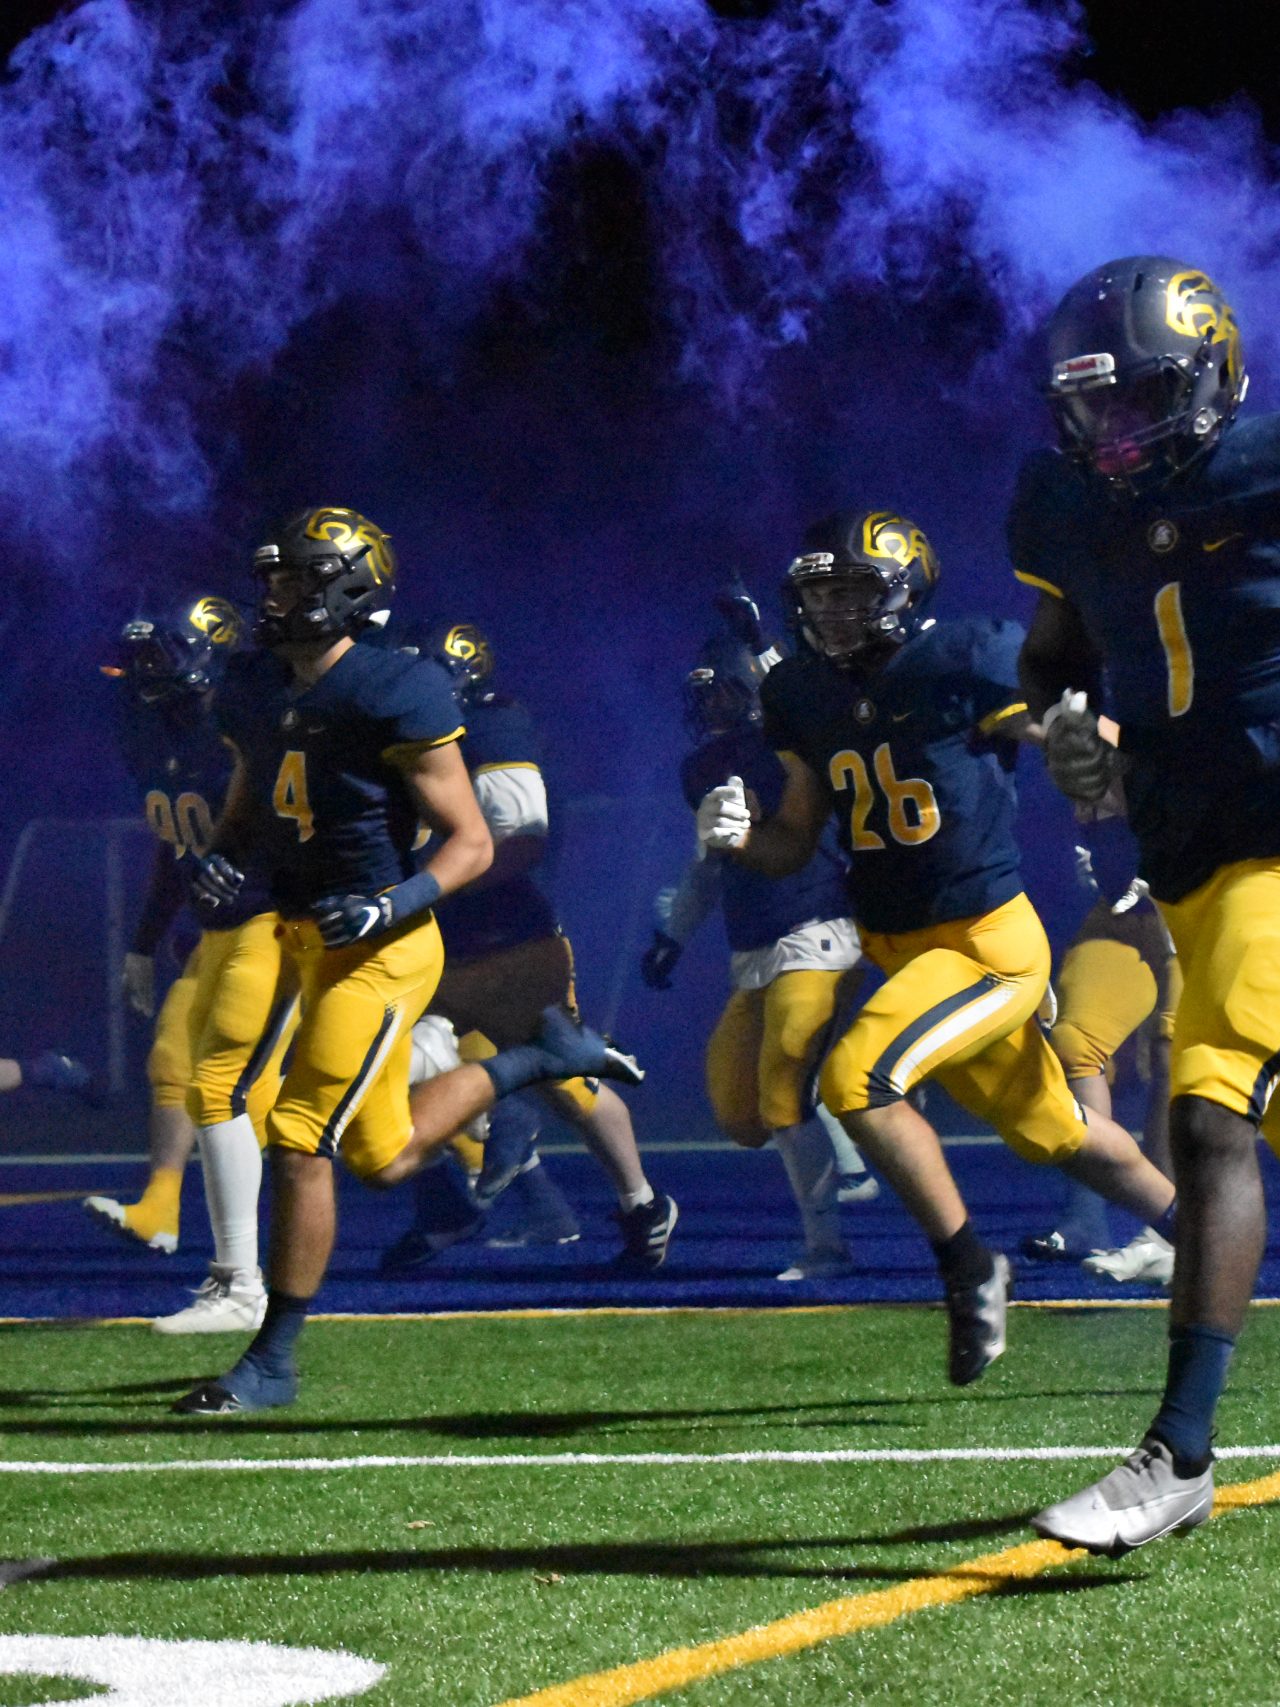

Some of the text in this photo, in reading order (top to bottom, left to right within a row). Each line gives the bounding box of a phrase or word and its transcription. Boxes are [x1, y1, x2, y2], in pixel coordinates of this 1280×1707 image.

[1154, 581, 1195, 717] 1
[145, 789, 216, 860] 90
[272, 750, 317, 843] 4
[828, 741, 941, 851] 26
